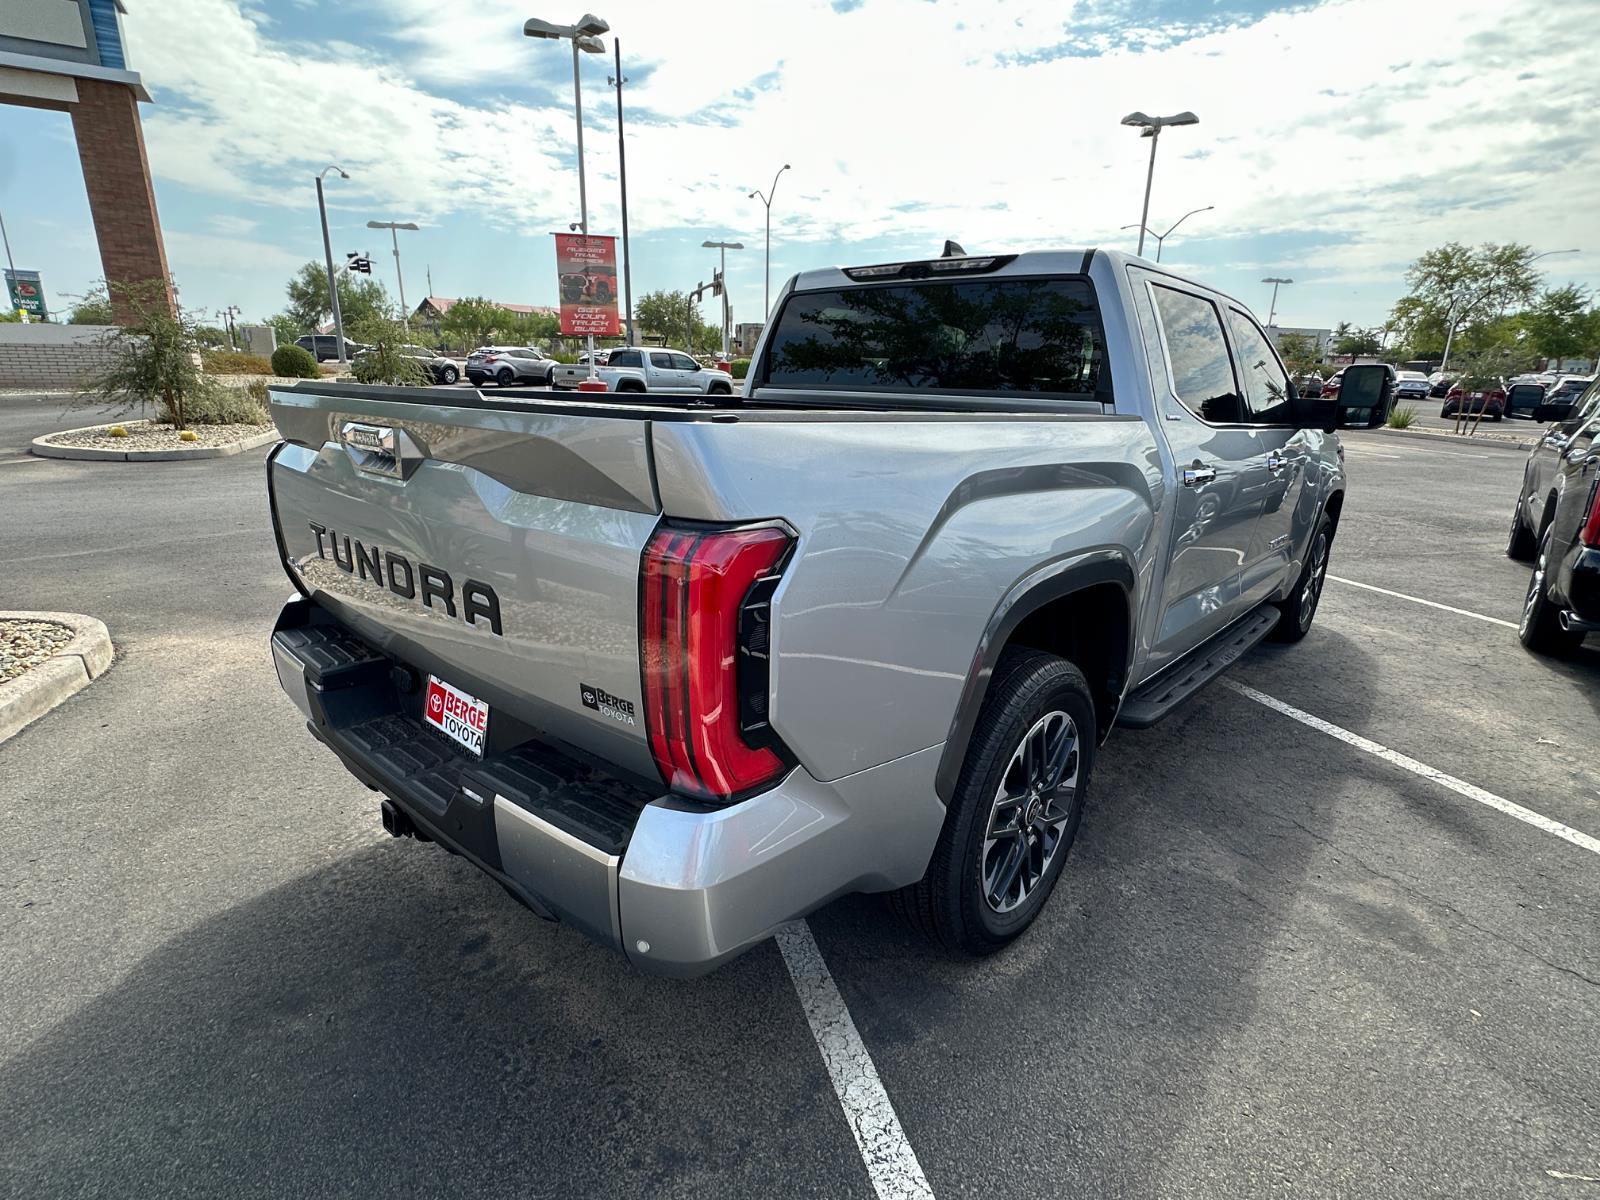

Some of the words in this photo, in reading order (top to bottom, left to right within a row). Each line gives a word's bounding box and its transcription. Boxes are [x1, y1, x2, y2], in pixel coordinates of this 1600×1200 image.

[570, 319, 610, 327] TRUCK
[308, 520, 503, 638] TUNDRA
[445, 691, 486, 731] BERGE
[596, 687, 635, 715] BERGE
[598, 705, 636, 727] TOYOTA
[443, 714, 483, 748] TOYOTA
